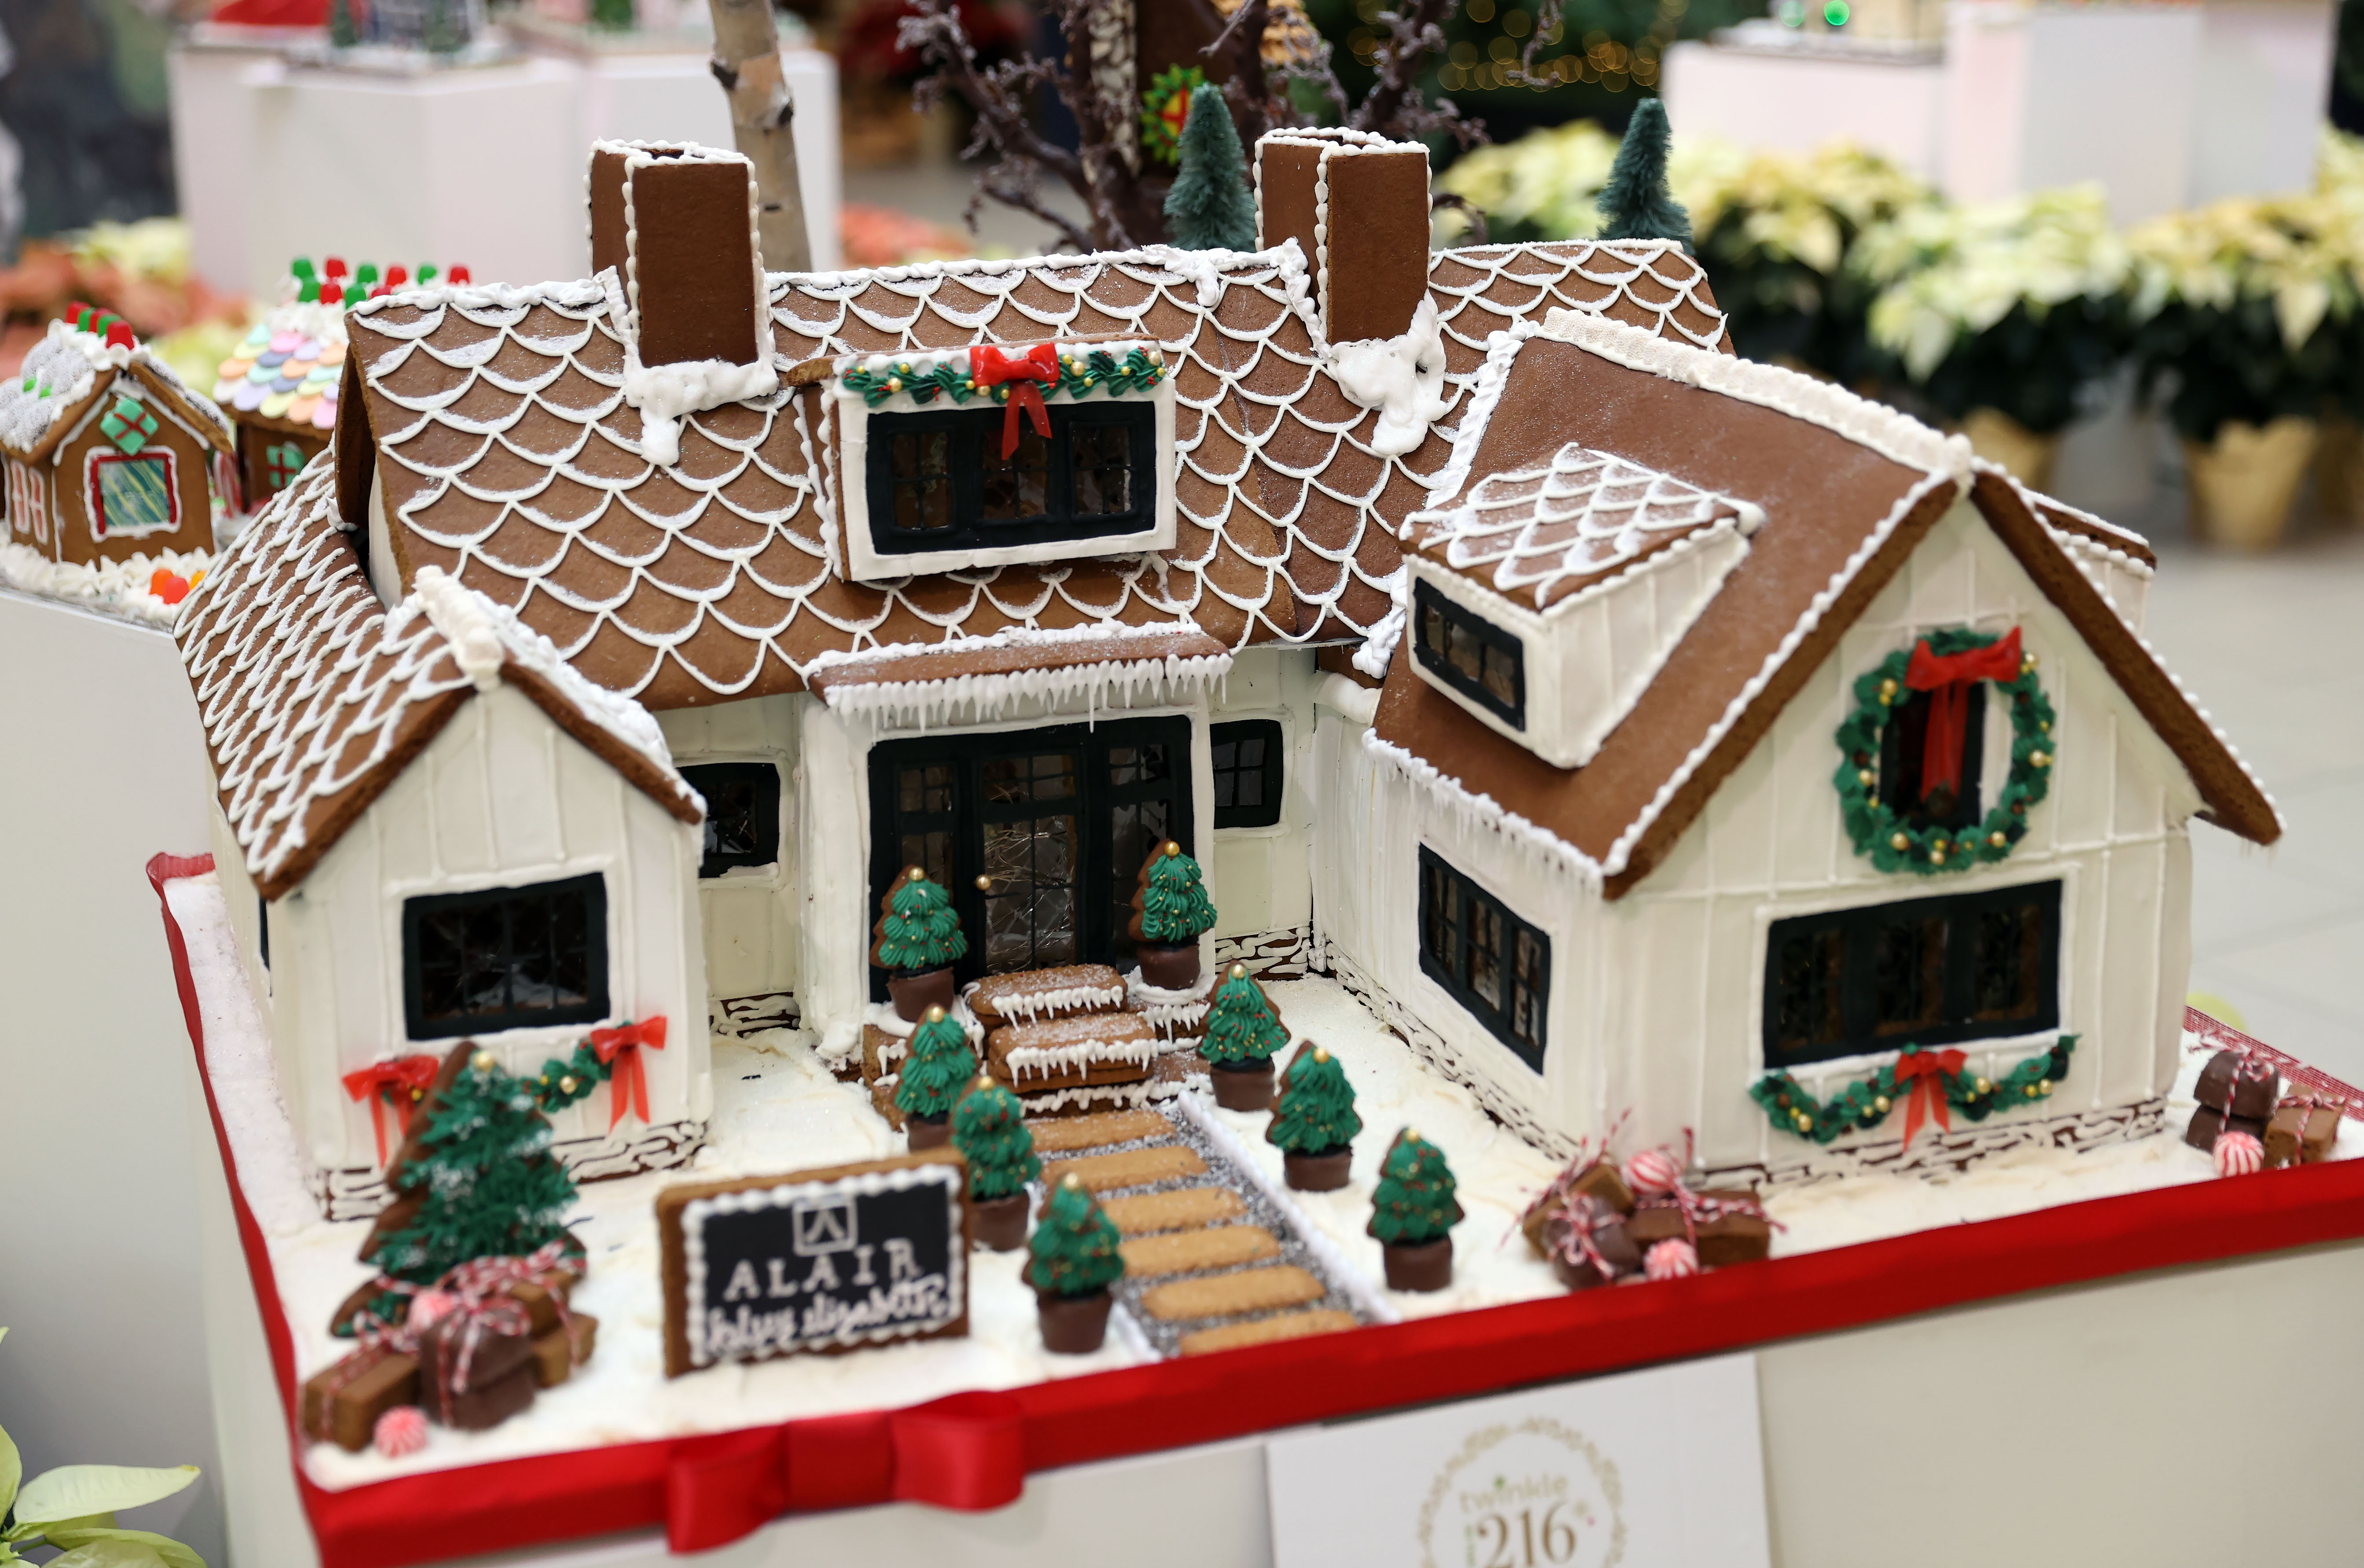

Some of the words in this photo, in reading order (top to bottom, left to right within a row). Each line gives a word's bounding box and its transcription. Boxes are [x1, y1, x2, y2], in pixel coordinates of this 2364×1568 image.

[722, 1237, 922, 1302] ALAIR
[1459, 1473, 1569, 1514] twinkle
[1476, 1498, 1577, 1568] 216
